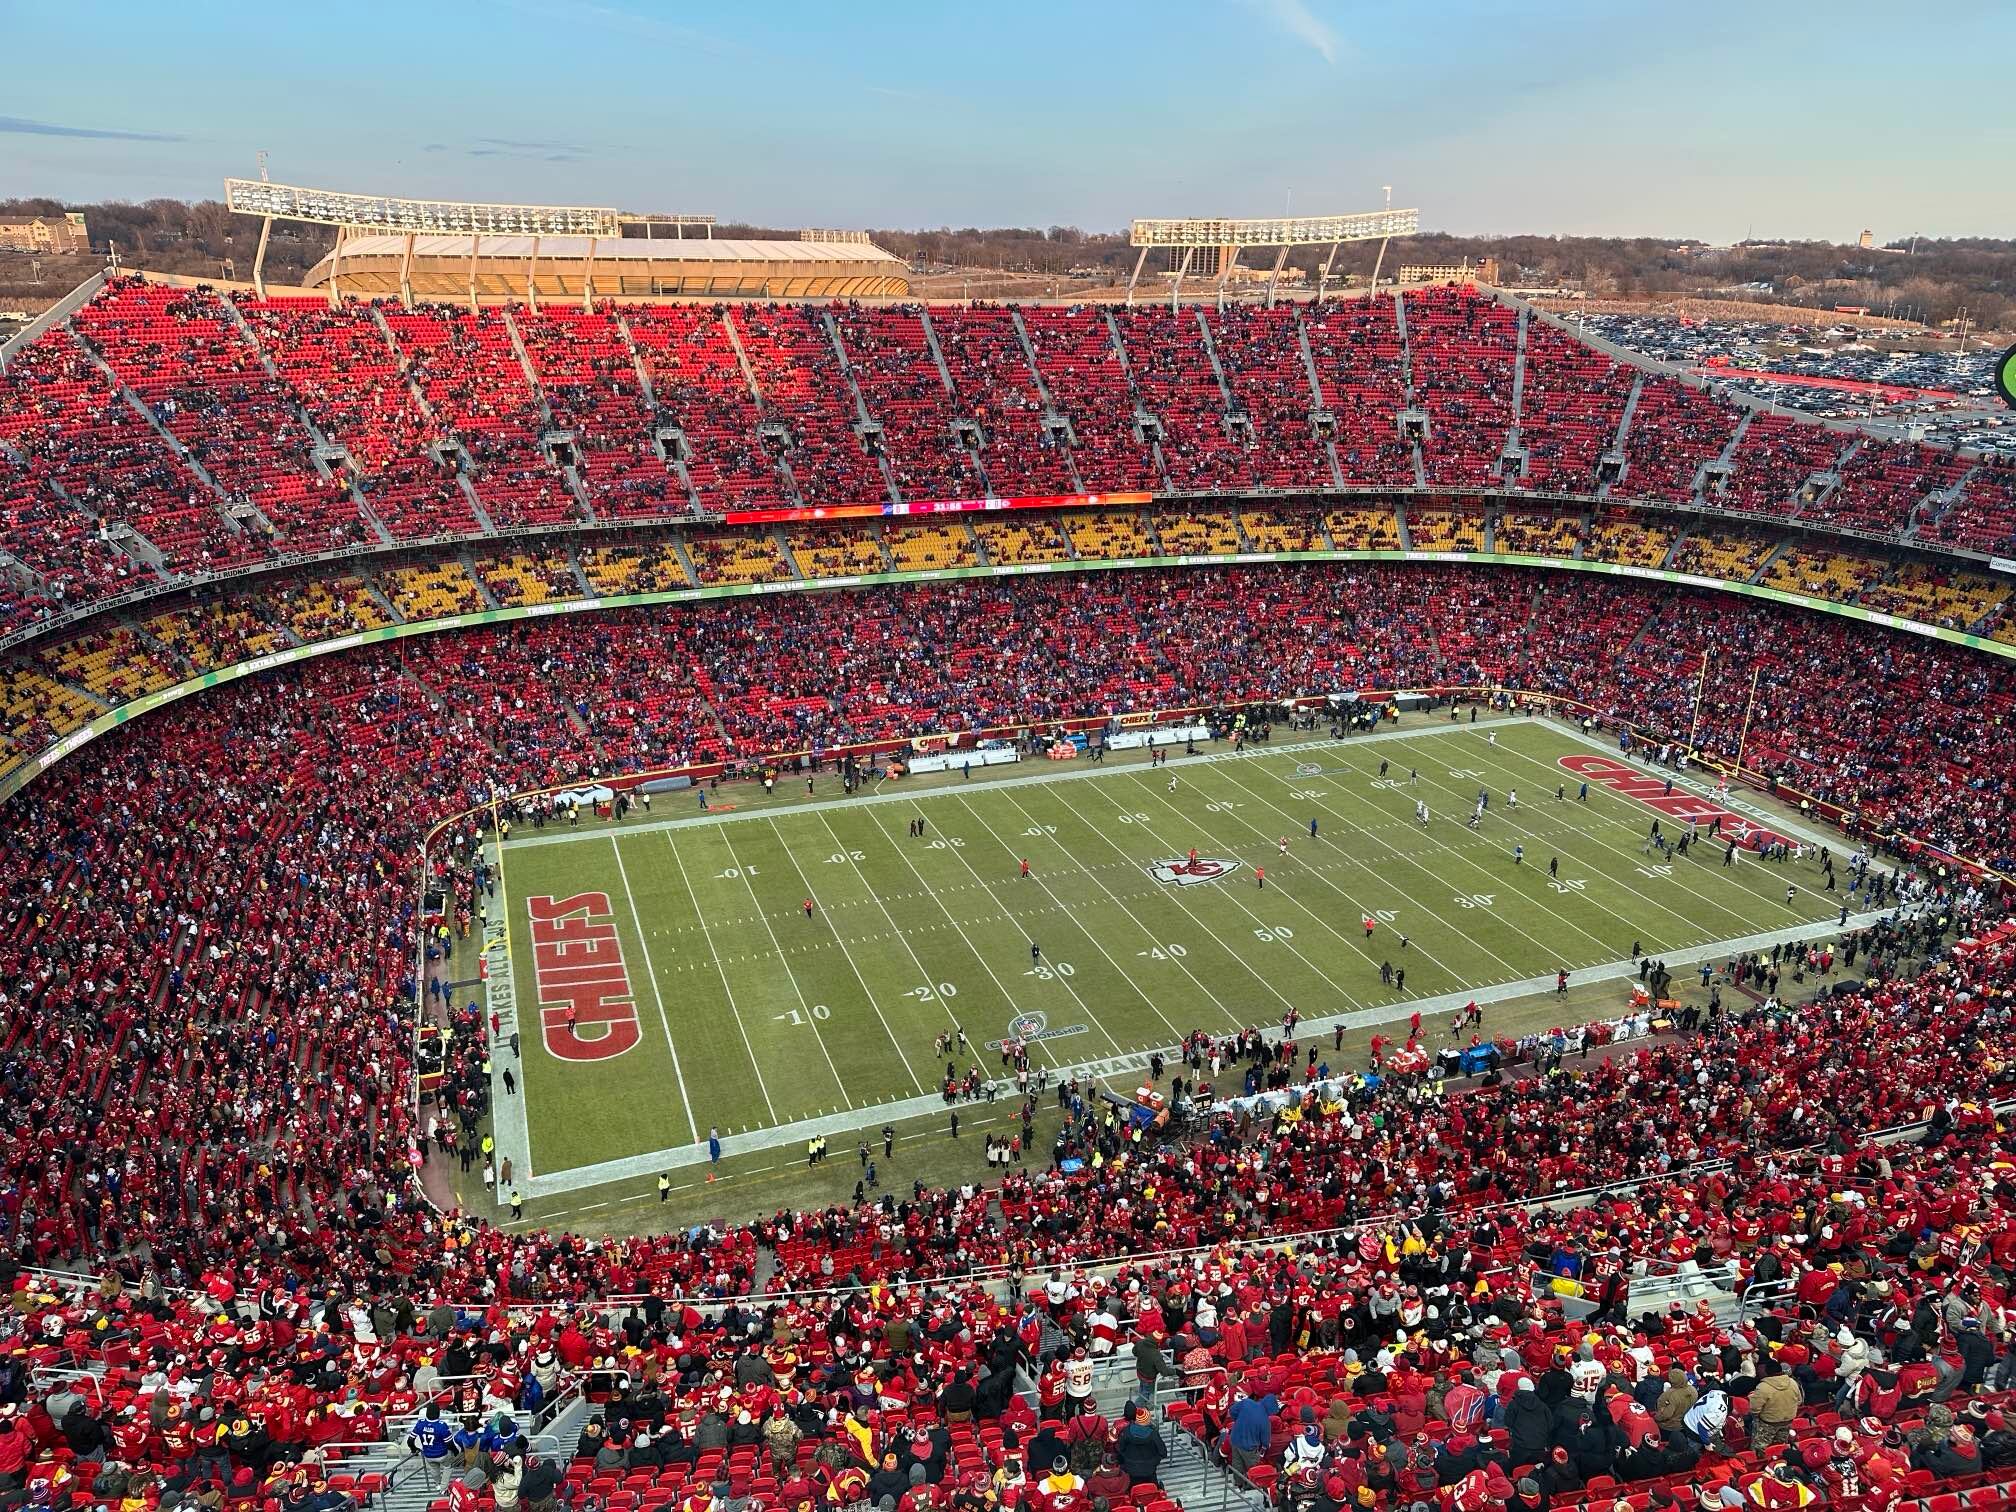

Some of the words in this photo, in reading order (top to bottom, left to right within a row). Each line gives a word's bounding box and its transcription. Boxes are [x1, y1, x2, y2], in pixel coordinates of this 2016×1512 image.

[1816, 524, 1842, 534] CARSON
[348, 546, 376, 555] CHERRY
[1928, 544, 1954, 553] WATERS
[223, 568, 251, 578] RUDNAY
[160, 580, 194, 593] HEADRICK
[764, 584, 786, 592] EXTRA
[96, 596, 132, 612] STENERUD
[526, 606, 554, 616] TREES
[562, 600, 600, 612] THREES
[50, 614, 74, 630] HAYNES
[1120, 716, 1149, 725] CHIEFS
[920, 736, 950, 748] CHIEFS
[1448, 768, 1476, 780] 10
[1370, 778, 1402, 790] 20
[1290, 790, 1322, 800] 30
[1206, 801, 1238, 812] 40
[1557, 755, 1808, 853] CHIEFS
[1118, 812, 1151, 824] 50
[1028, 824, 1058, 837] 40
[931, 837, 966, 850] 30
[831, 850, 866, 864] 20
[724, 865, 760, 879] 10
[1634, 864, 1668, 879] 10
[1548, 880, 1582, 894] 20
[1453, 894, 1492, 910] 30
[1361, 908, 1394, 925] 40
[1254, 926, 1294, 943] 50
[1150, 944, 1188, 962] 40
[490, 956, 510, 978] ALL
[1036, 962, 1075, 980] 30
[527, 892, 643, 1062] CHIEFS
[916, 982, 958, 1002] 20
[490, 984, 514, 1026] TAKES
[784, 1005, 831, 1026] 10
[989, 1026, 1084, 1050] CPIONSHIP
[1832, 1163, 1842, 1172] 15
[1747, 1227, 1760, 1236] 87
[1210, 1270, 1222, 1282] 32
[1299, 1294, 1310, 1306] 87
[911, 1306, 921, 1316] 15
[862, 1313, 874, 1324] 87
[814, 1322, 826, 1332] 87
[244, 1332, 261, 1344] 56
[1072, 1373, 1091, 1386] 58
[1584, 1376, 1600, 1392] 15
[680, 1425, 697, 1440] 15
[165, 1436, 184, 1448] 52
[422, 1434, 434, 1446] 17
